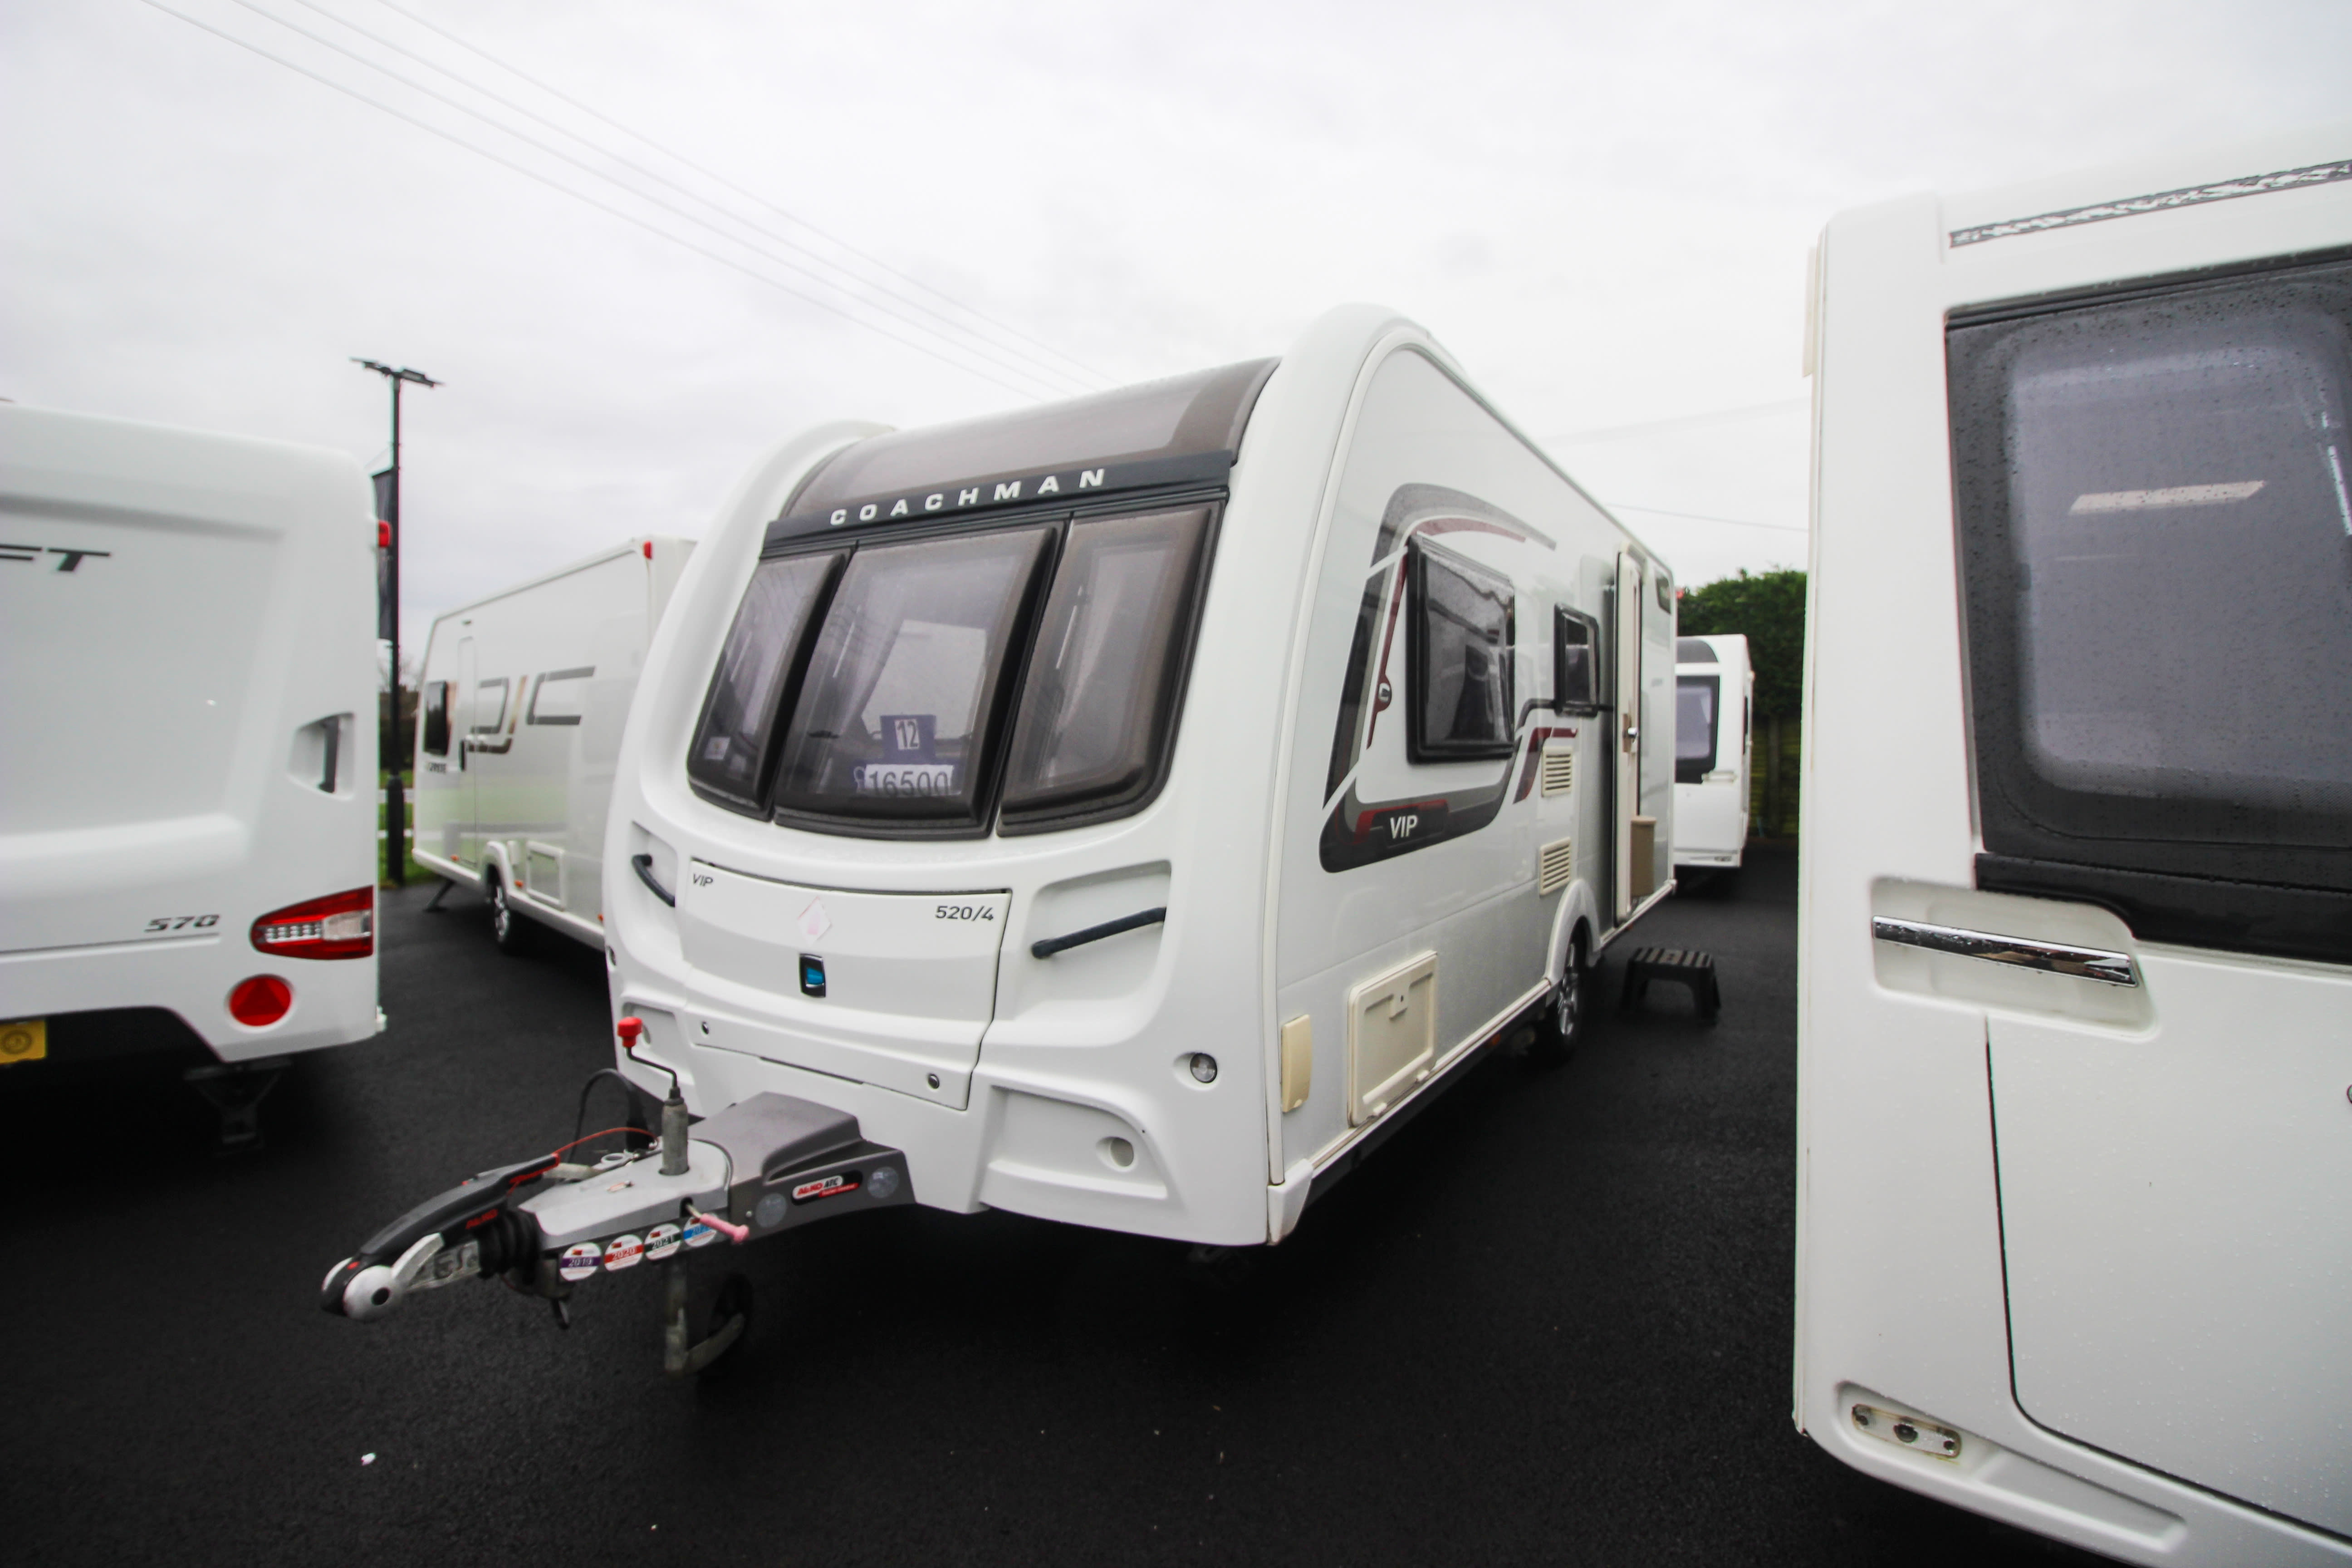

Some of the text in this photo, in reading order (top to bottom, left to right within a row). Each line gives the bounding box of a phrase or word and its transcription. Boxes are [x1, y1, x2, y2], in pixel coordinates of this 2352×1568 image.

[830, 468, 1105, 525] COACHMAN
[897, 720, 919, 747] 12
[1390, 814, 1418, 839] VIP
[693, 873, 714, 887] VIP
[144, 914, 220, 931] 570
[935, 906, 994, 921] 520/4
